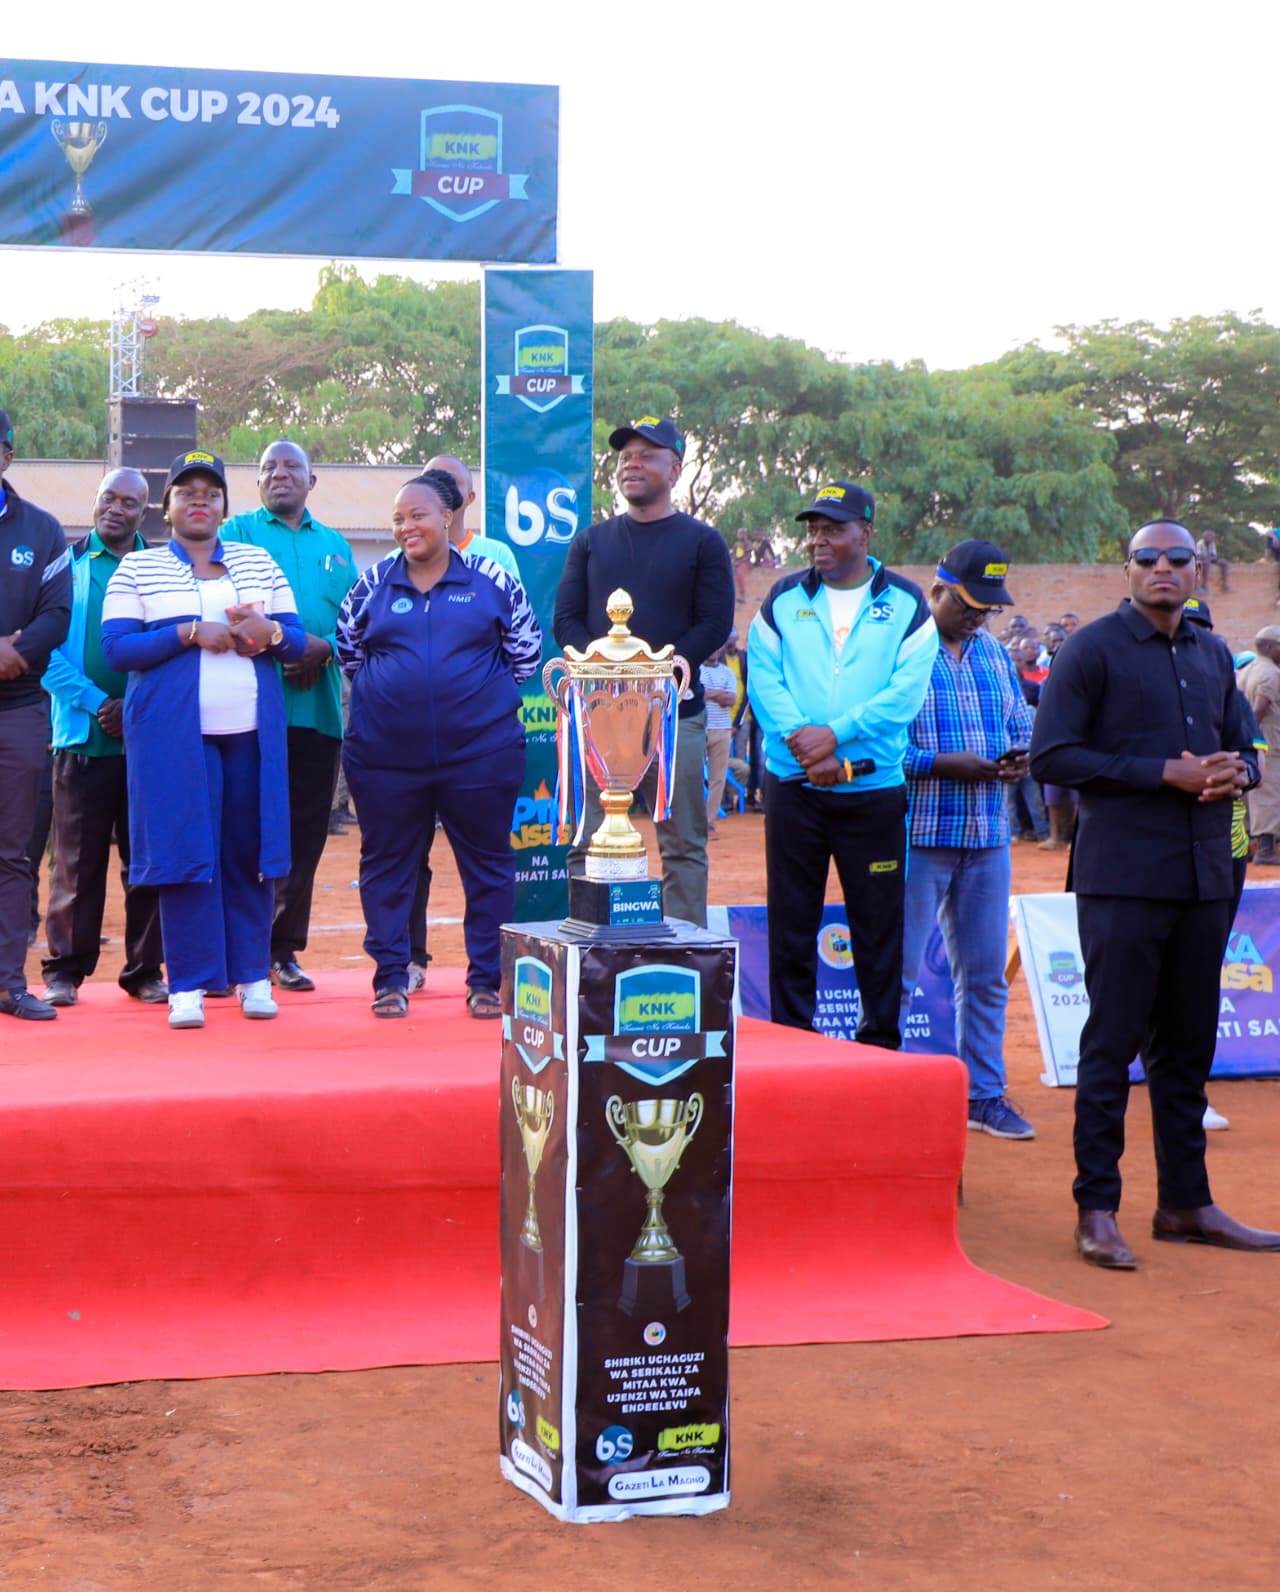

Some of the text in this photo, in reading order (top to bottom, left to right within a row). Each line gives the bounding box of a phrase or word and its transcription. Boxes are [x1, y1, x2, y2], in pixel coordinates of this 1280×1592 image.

[34, 81, 132, 119] KNK
[140, 87, 228, 122] CUP
[236, 92, 340, 129] 2024
[445, 141, 480, 155] KNK
[438, 174, 484, 195] CUP
[531, 352, 554, 362] KNK
[526, 378, 556, 393] CUP
[532, 855, 549, 867] NA
[515, 869, 569, 882] SHATI SA
[613, 900, 660, 913] BINGWA
[824, 989, 860, 1000] UCHA
[639, 1002, 675, 1016] KNK
[818, 1003, 858, 1013] SERIK
[814, 1017, 841, 1028] TAA
[906, 1014, 930, 1025] NZI
[1248, 1018, 1280, 1037] SA
[523, 1025, 545, 1048] CUP
[904, 1027, 931, 1038] EVU
[631, 1037, 682, 1058] CUP
[604, 1352, 705, 1368] SHIRIKI UCHAGUZI
[609, 1364, 699, 1379] WA SERIKALI ZA
[622, 1377, 687, 1390] MITAA KWA
[606, 1387, 701, 1403] UJENZI WA TAIFA
[622, 1400, 687, 1413] ENDEELEVU
[676, 1431, 704, 1445] KNK
[615, 1480, 649, 1491] GAZETI
[651, 1476, 664, 1489] LA
